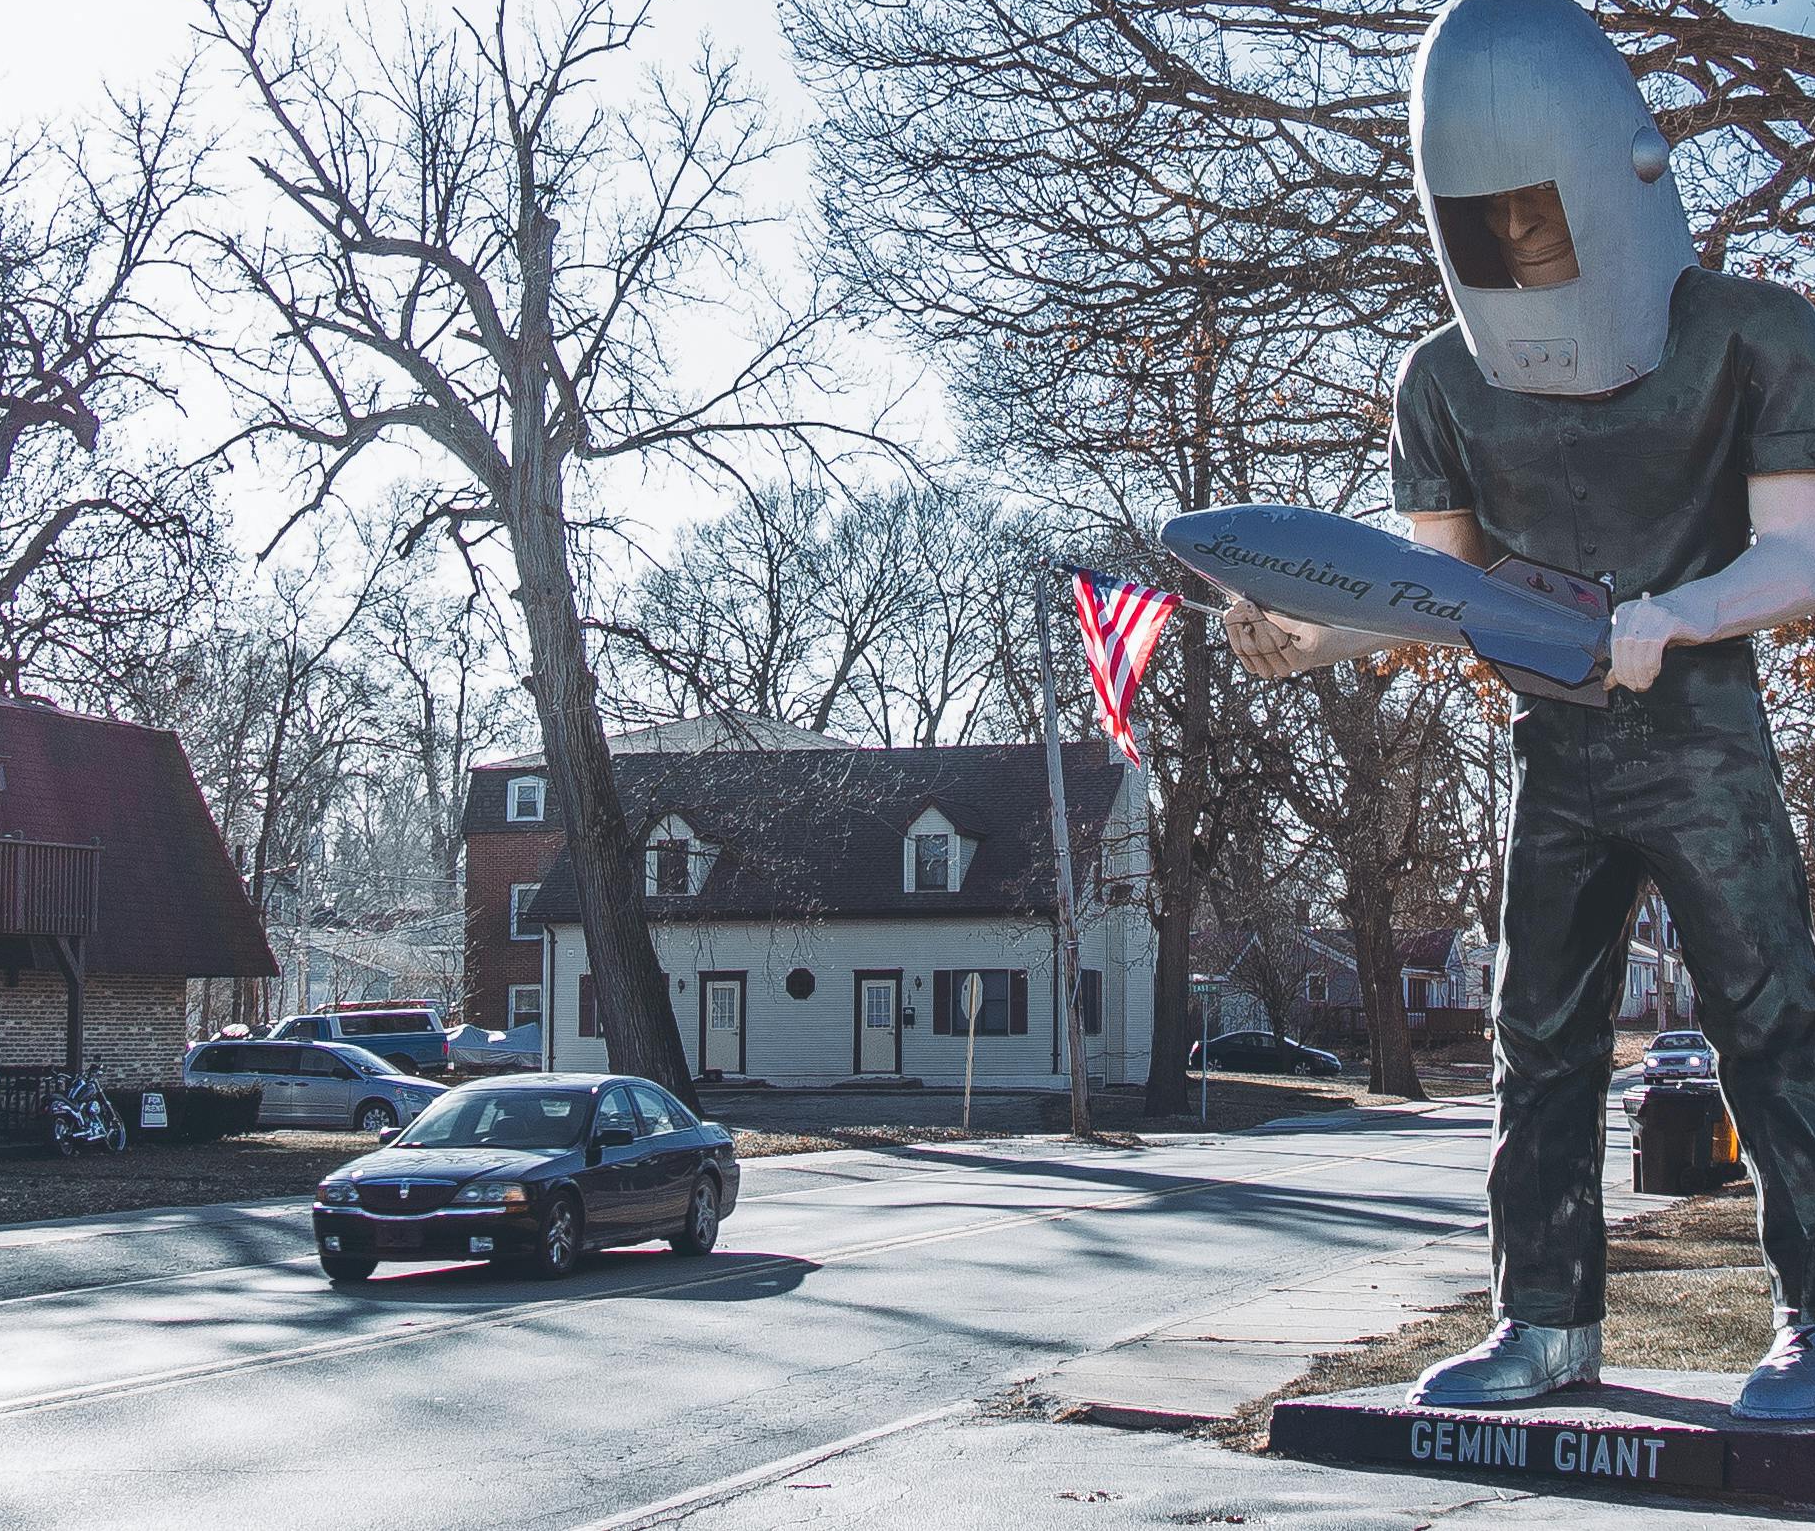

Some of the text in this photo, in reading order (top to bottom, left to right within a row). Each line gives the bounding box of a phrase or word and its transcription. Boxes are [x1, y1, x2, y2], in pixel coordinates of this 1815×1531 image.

[1194, 534, 1468, 622] Launching Pad
[1411, 1420, 1665, 1478] GEMINI GIANT
